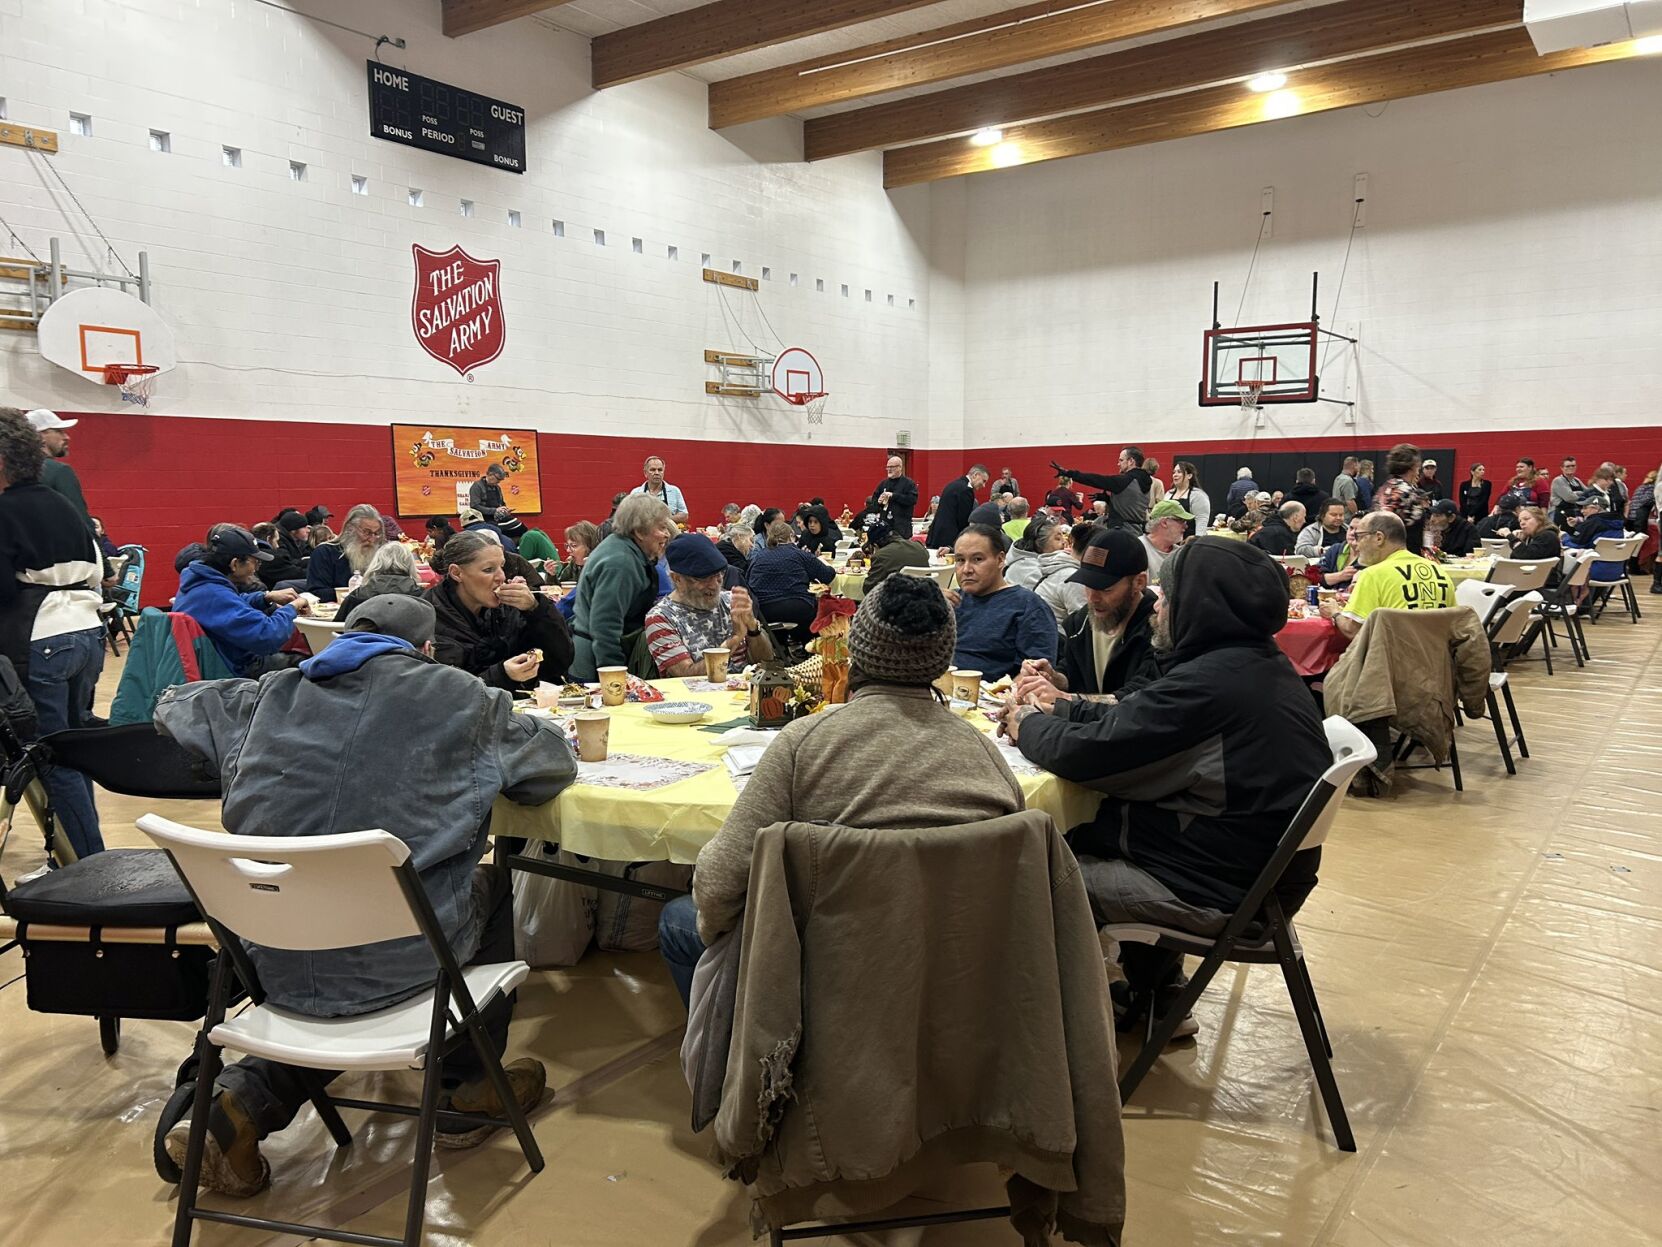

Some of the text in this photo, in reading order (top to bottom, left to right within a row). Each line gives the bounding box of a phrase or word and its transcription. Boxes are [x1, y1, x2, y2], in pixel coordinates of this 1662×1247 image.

[374, 68, 409, 92] HOME
[422, 114, 438, 126] POSS
[491, 105, 523, 126] GUEST
[383, 124, 413, 140] BONUS
[422, 127, 455, 144] PERIOD
[469, 128, 485, 138] POSS
[493, 154, 519, 167] BONUS
[430, 261, 464, 296] THE
[420, 272, 494, 338] SALVATION
[449, 306, 492, 358] ARMY
[450, 447, 486, 458] SALVATION
[487, 441, 506, 450] ARMY
[430, 470, 480, 478] THANKSGIVING
[1395, 563, 1446, 581] VOL
[1402, 582, 1448, 602] UNT
